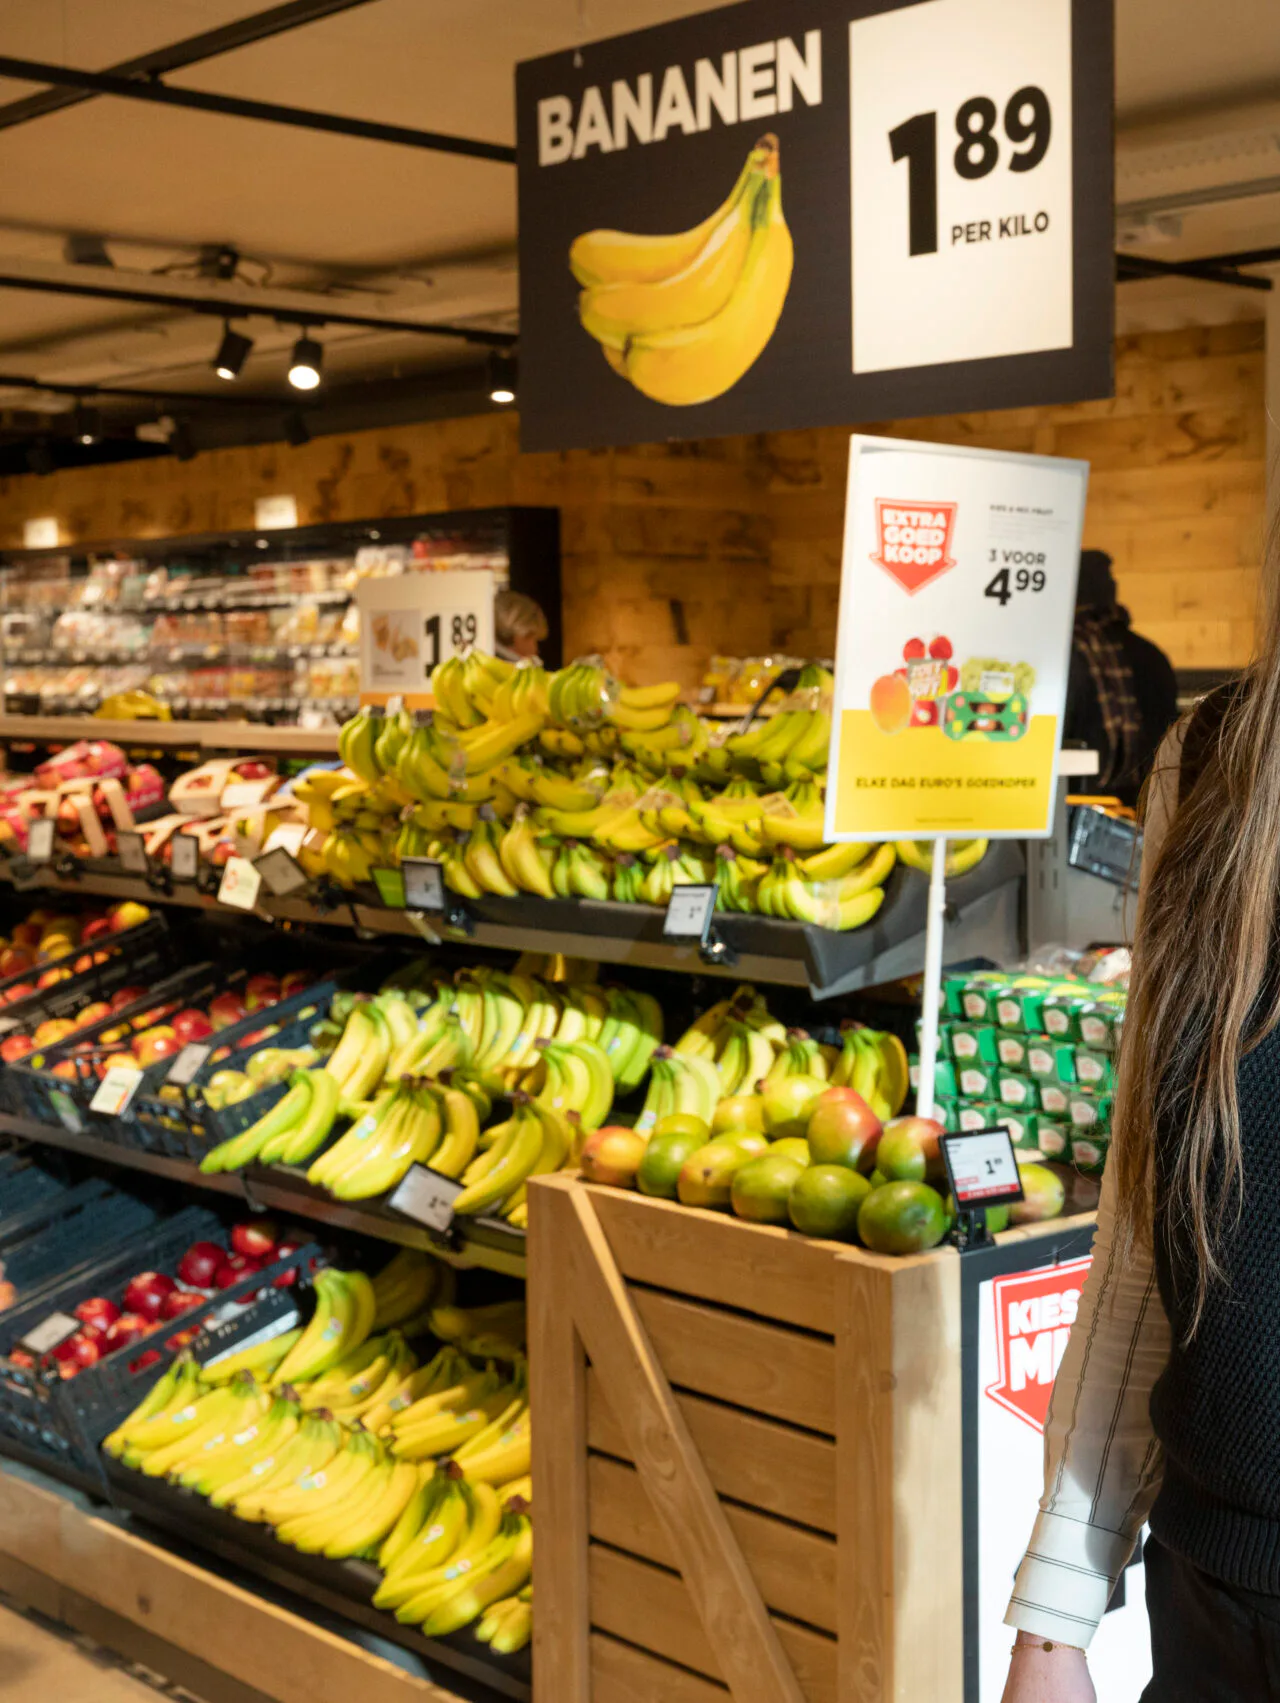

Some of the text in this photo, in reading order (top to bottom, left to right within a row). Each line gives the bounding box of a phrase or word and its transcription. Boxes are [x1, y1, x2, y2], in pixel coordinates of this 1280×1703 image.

[538, 30, 822, 167] BANANEN
[951, 211, 1051, 246] PER KILO
[882, 508, 947, 528] EXTRA
[884, 526, 946, 546] GOED
[884, 543, 943, 566] KOOP
[989, 548, 1046, 566] 3 VOOR
[1008, 1288, 1081, 1337] KIES
[1009, 1327, 1071, 1392] MI
